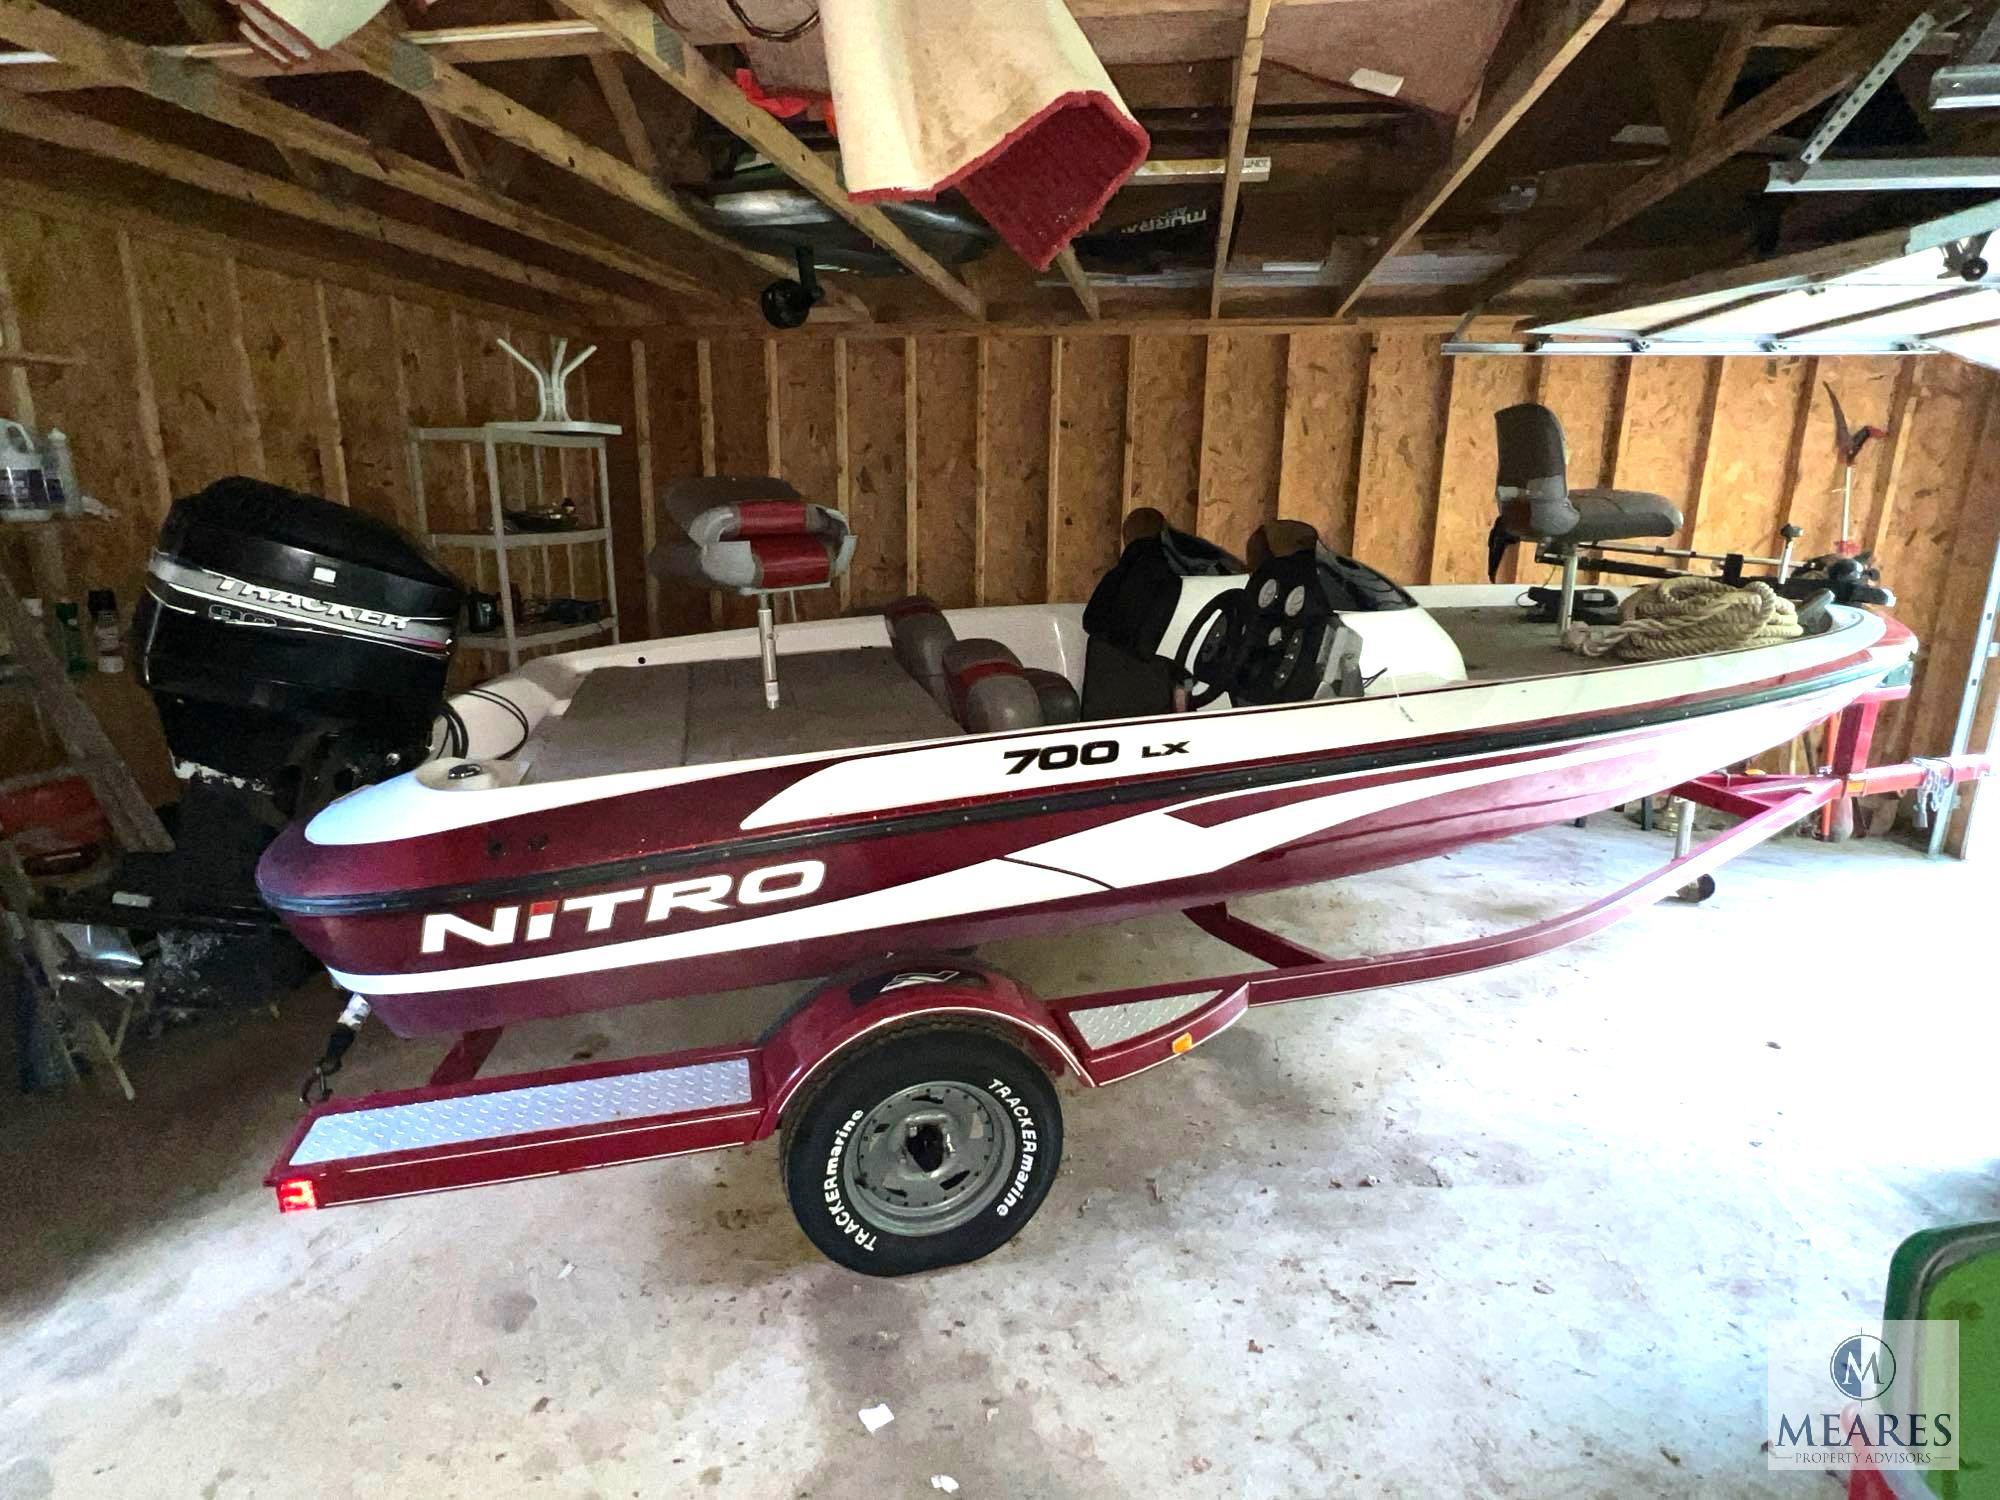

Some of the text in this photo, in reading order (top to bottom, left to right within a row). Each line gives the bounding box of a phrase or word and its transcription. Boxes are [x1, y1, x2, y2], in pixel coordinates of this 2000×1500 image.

[1120, 208, 1208, 234] MURRA
[210, 575, 412, 630] TRACKER
[1003, 739, 1190, 775] 700 LX
